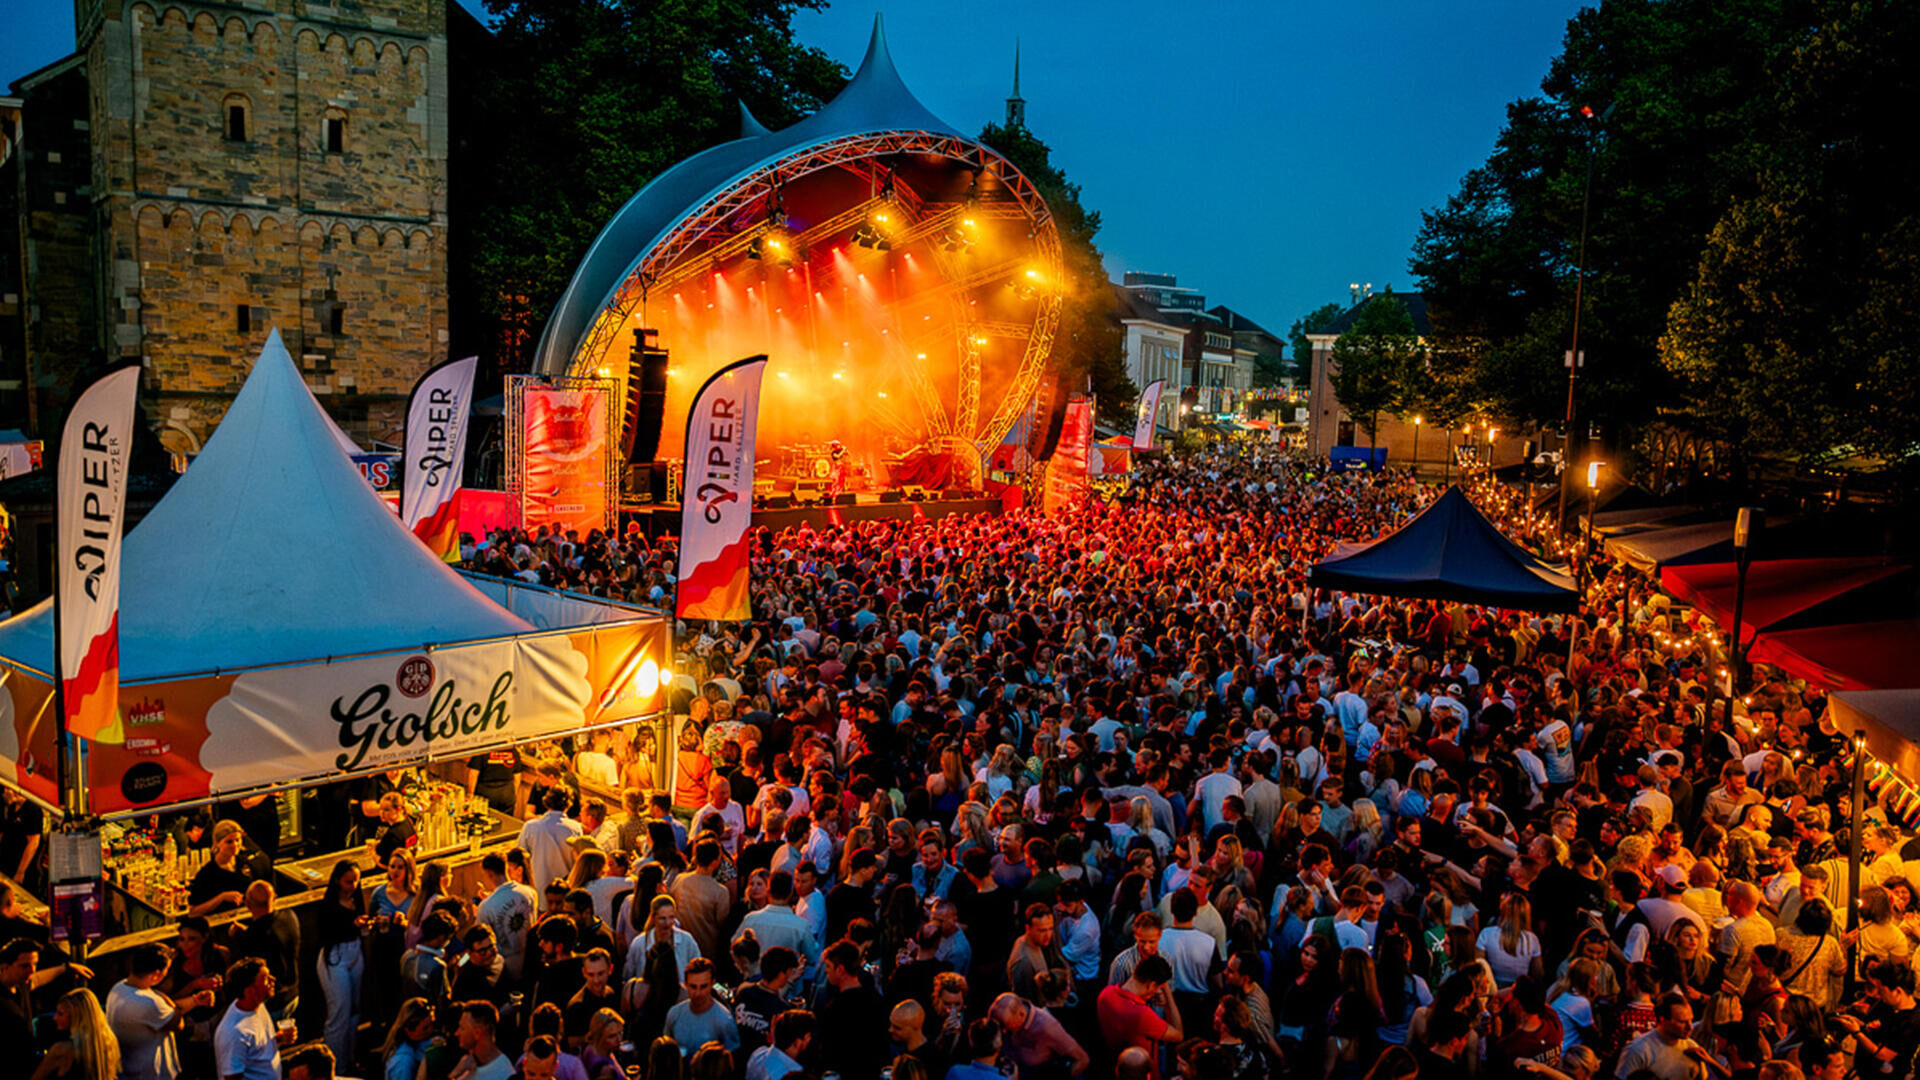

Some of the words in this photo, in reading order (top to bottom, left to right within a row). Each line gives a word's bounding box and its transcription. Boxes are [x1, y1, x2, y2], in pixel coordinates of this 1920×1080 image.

[419, 388, 452, 487] VIPER
[697, 397, 738, 524] VIPER
[733, 457, 741, 486] HARD
[75, 421, 110, 602] VIPER
[130, 711, 165, 724] VHSE
[330, 671, 513, 771] Grolsch
